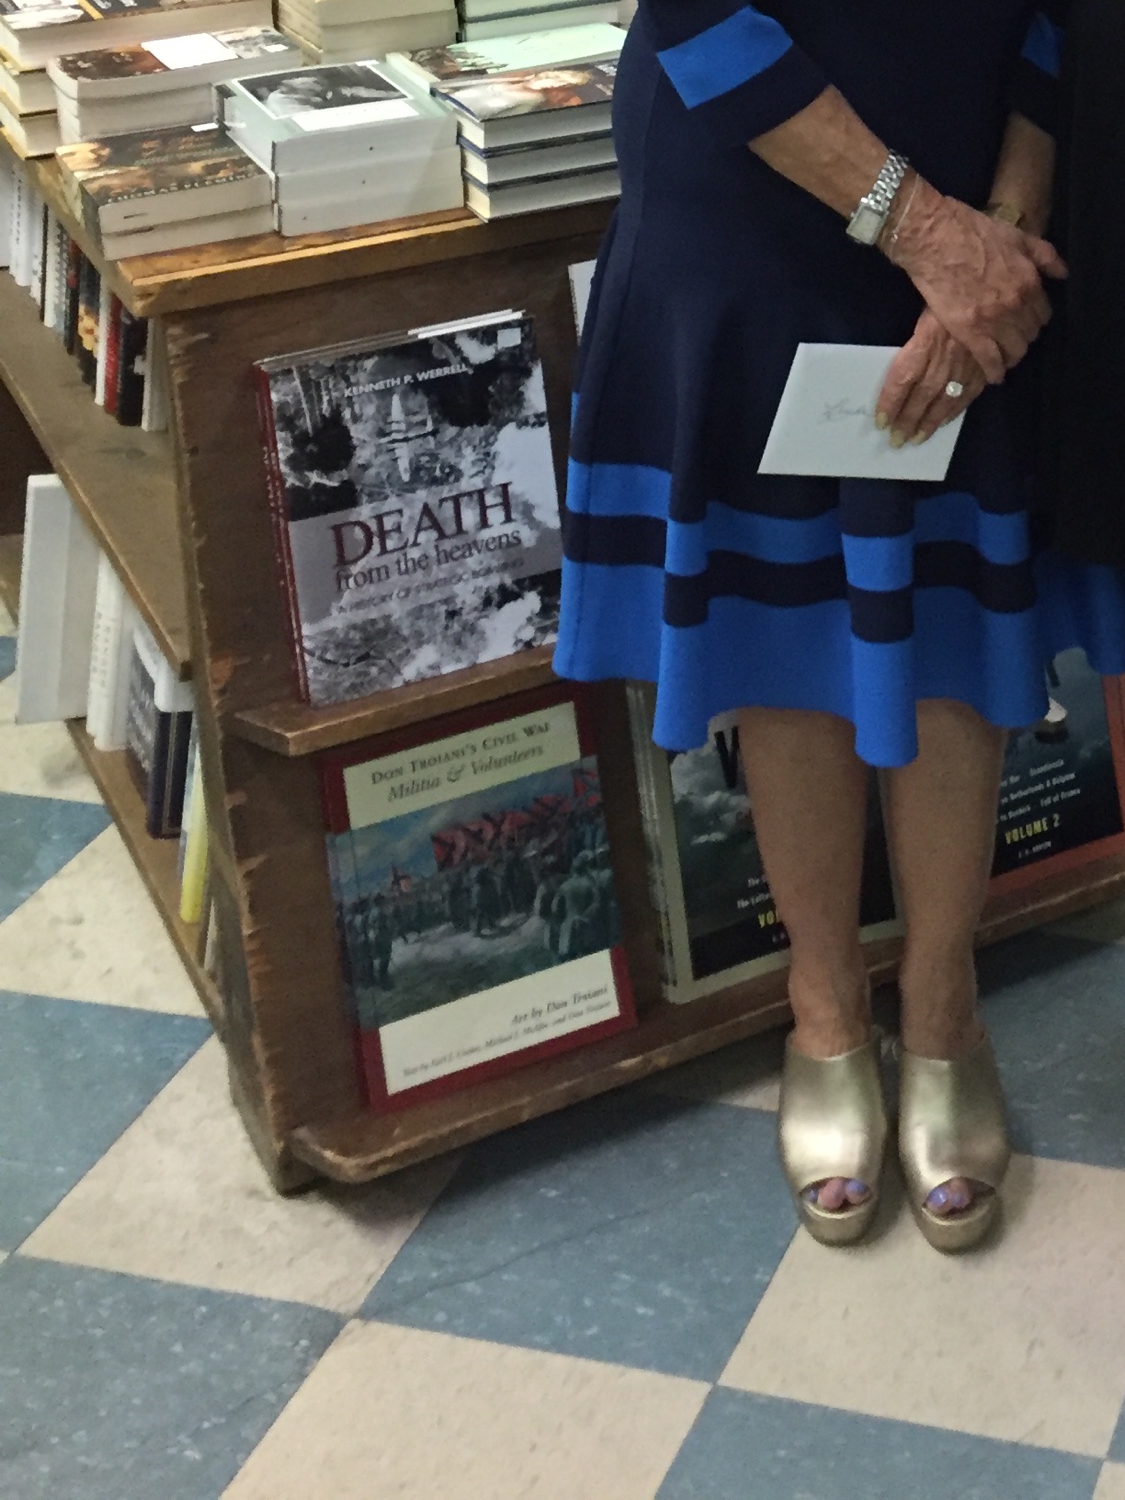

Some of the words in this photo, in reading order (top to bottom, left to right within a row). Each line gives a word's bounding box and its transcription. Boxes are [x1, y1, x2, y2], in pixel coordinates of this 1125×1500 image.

[343, 376, 401, 398] KENNETH
[416, 363, 472, 383] WERRELL
[331, 482, 513, 567] DEATH
[335, 560, 389, 591] from
[394, 545, 430, 576] the
[435, 527, 522, 564] heavens
[387, 776, 441, 803] Militia
[446, 763, 465, 783] &
[470, 744, 544, 775] Volunteers
[1004, 817, 1048, 845] VOLUME
[1052, 813, 1060, 828] 2
